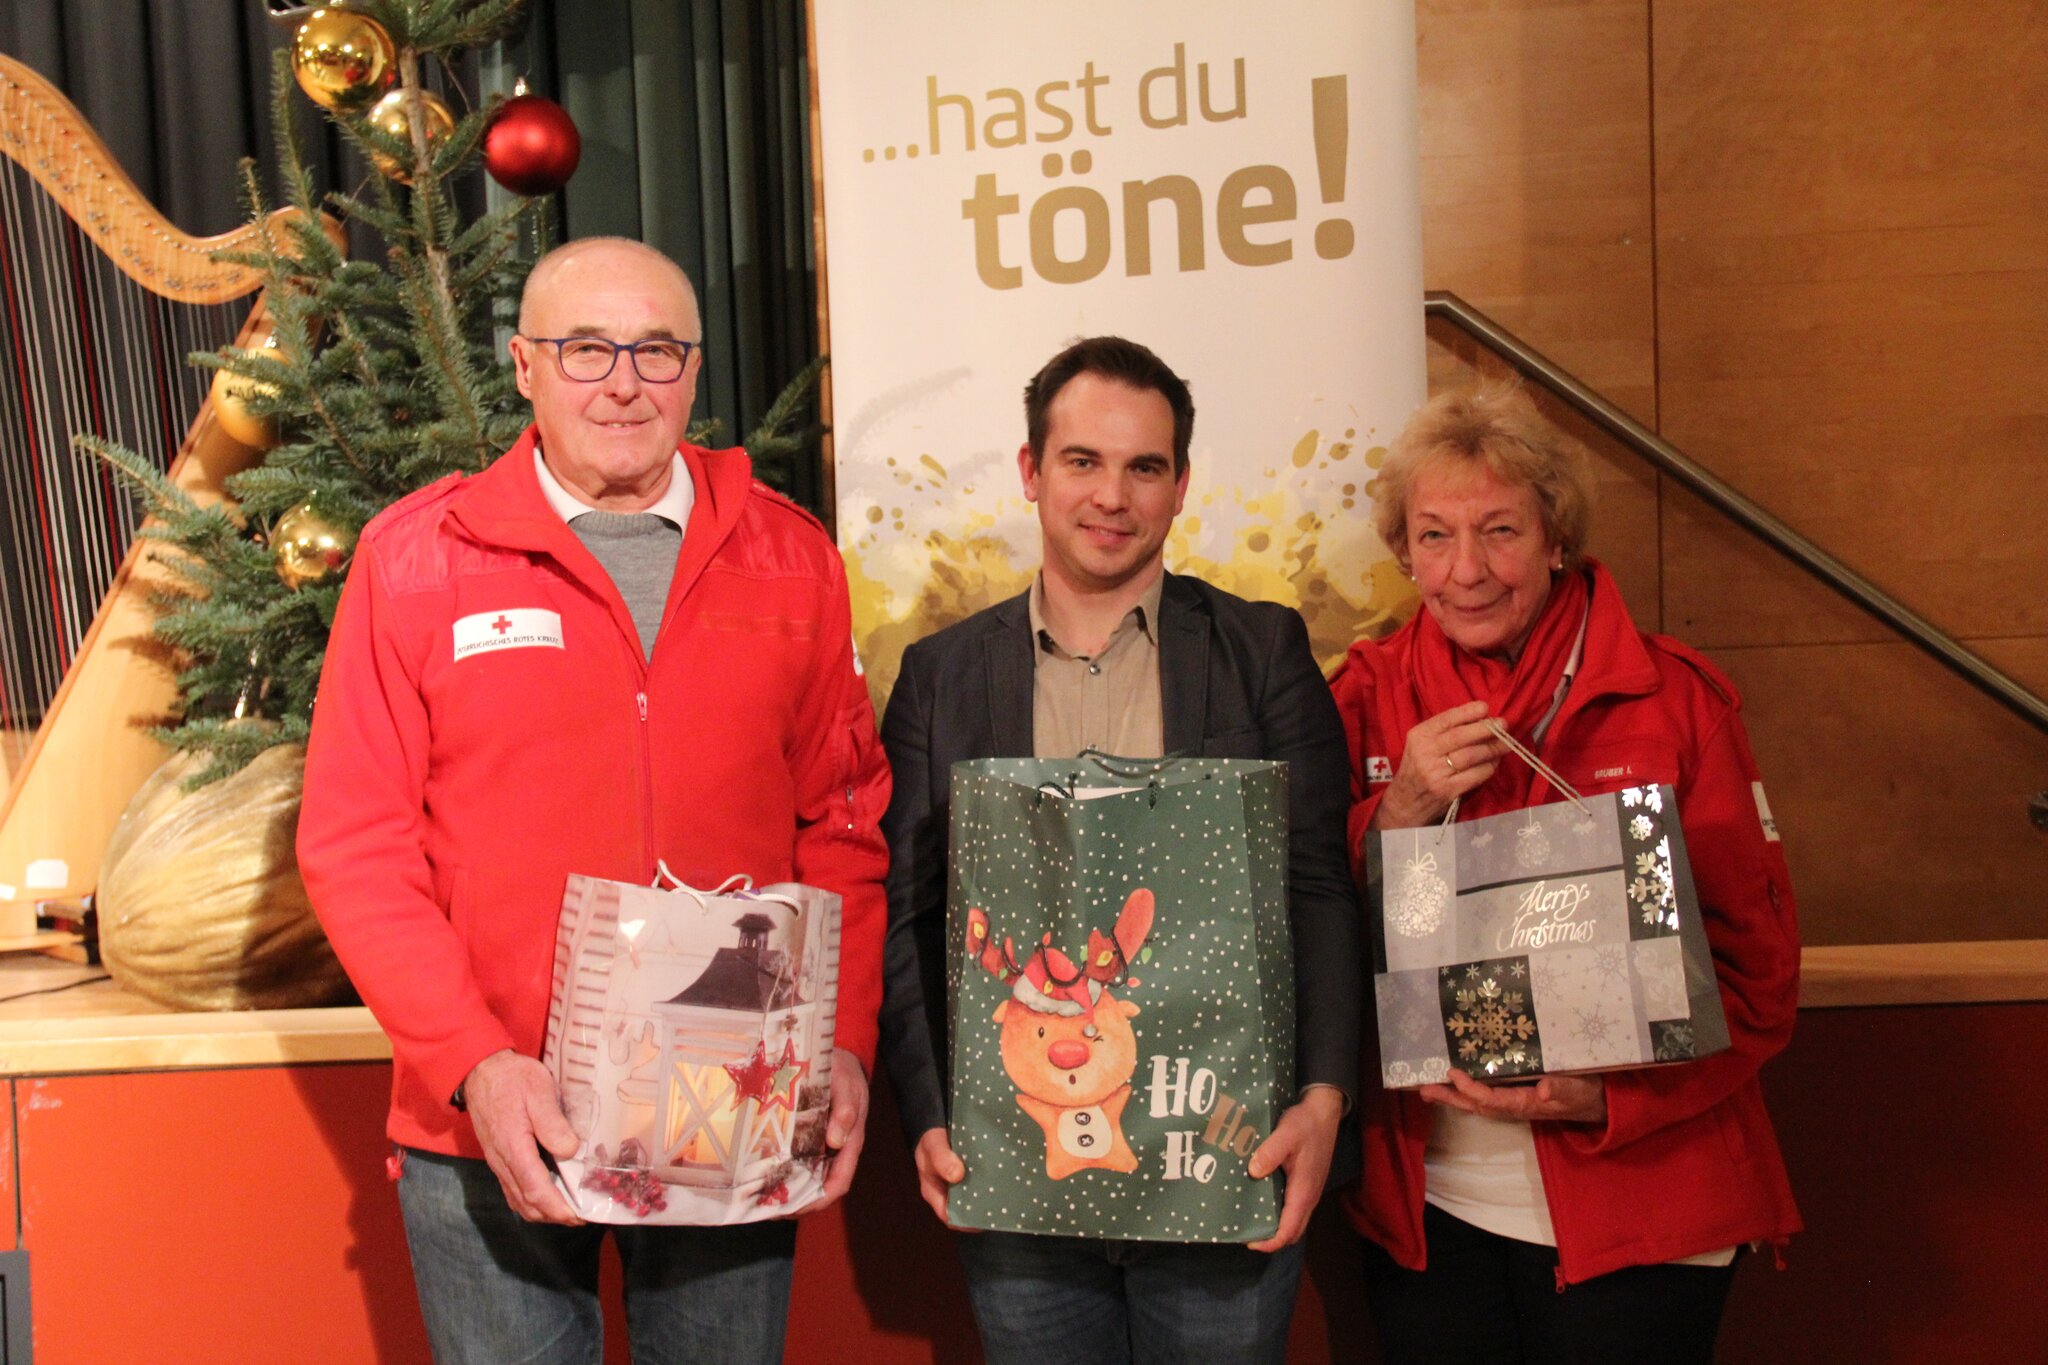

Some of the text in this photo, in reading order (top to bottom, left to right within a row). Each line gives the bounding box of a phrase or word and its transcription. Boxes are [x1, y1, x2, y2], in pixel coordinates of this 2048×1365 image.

[862, 42, 1248, 163] ...hast du
[961, 74, 1355, 291] töne!
[513, 635, 535, 643] ROTES
[1516, 880, 1590, 922] Merry
[1496, 912, 1597, 952] Christmas
